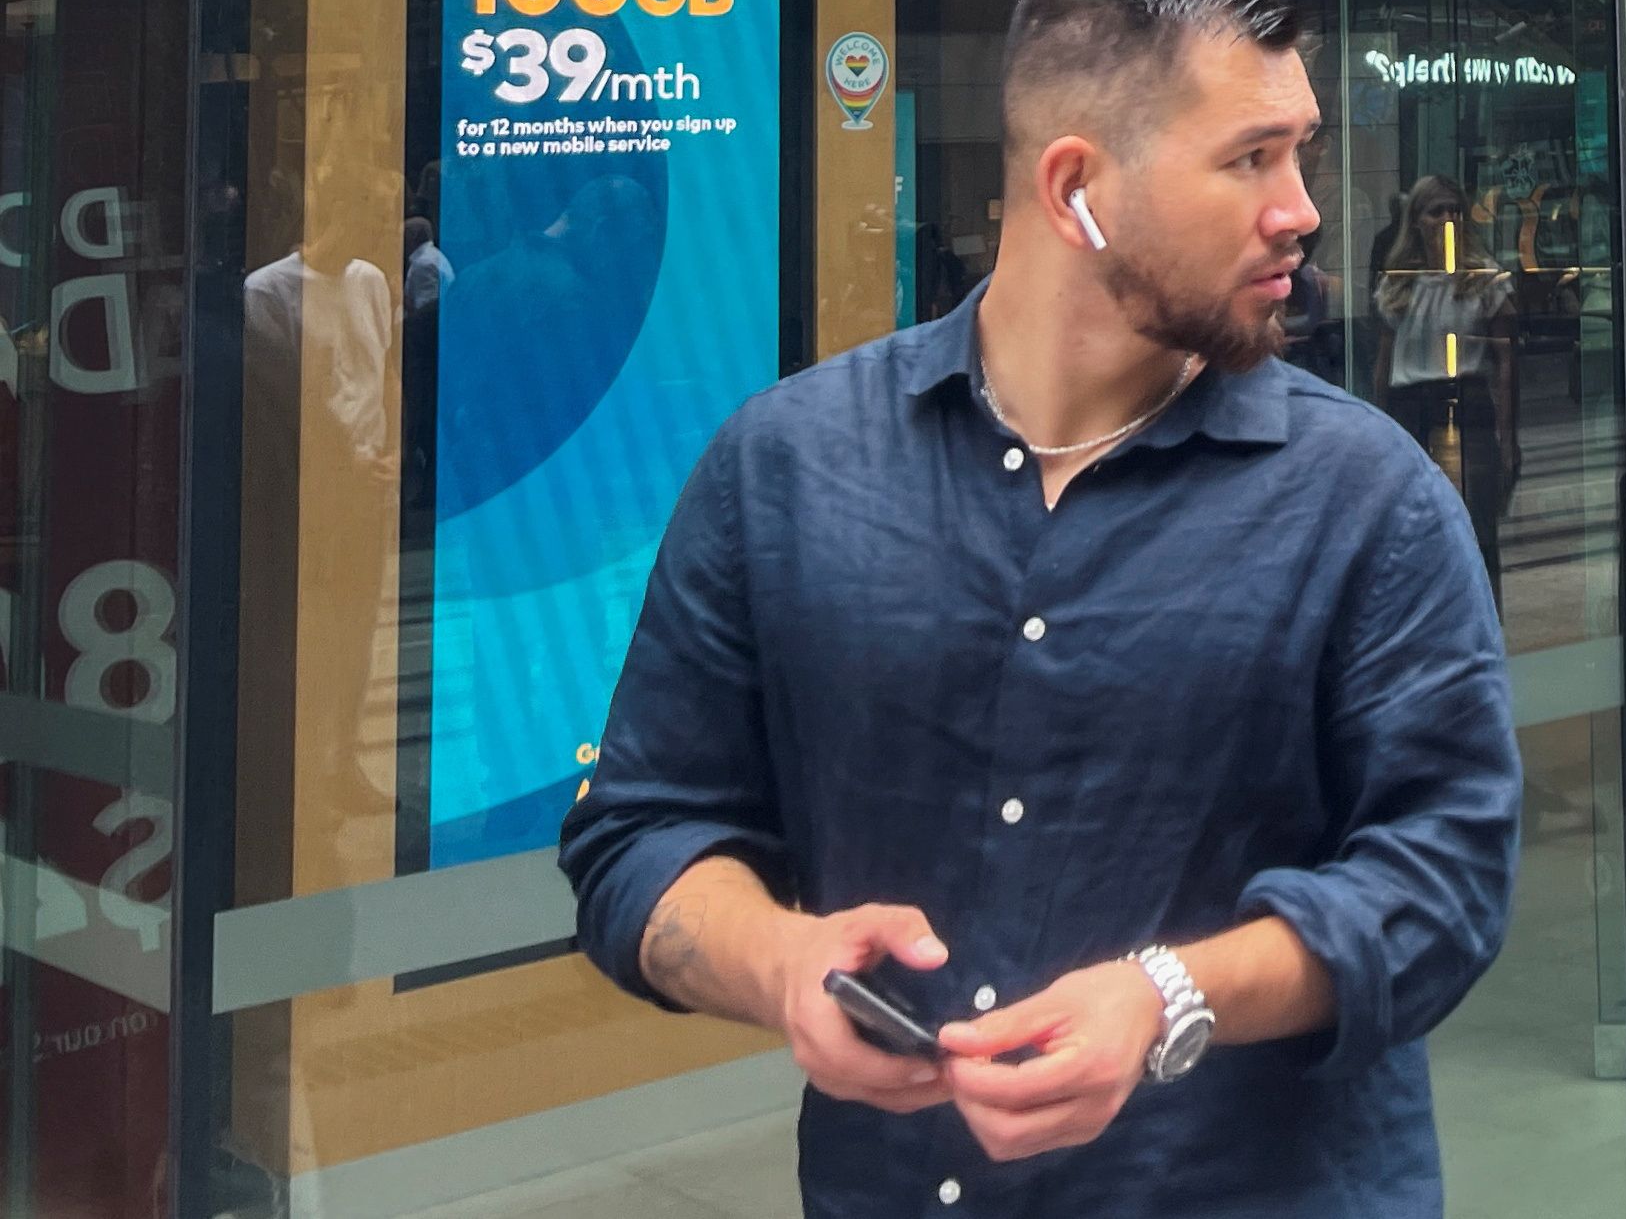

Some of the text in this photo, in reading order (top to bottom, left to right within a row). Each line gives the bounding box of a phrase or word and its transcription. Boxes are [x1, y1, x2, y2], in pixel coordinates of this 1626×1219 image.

[460, 27, 700, 104] $39/mth
[834, 40, 880, 66] WELCOME
[457, 114, 738, 137] for 12 months when you sign up
[456, 133, 672, 157] to a new mobile service
